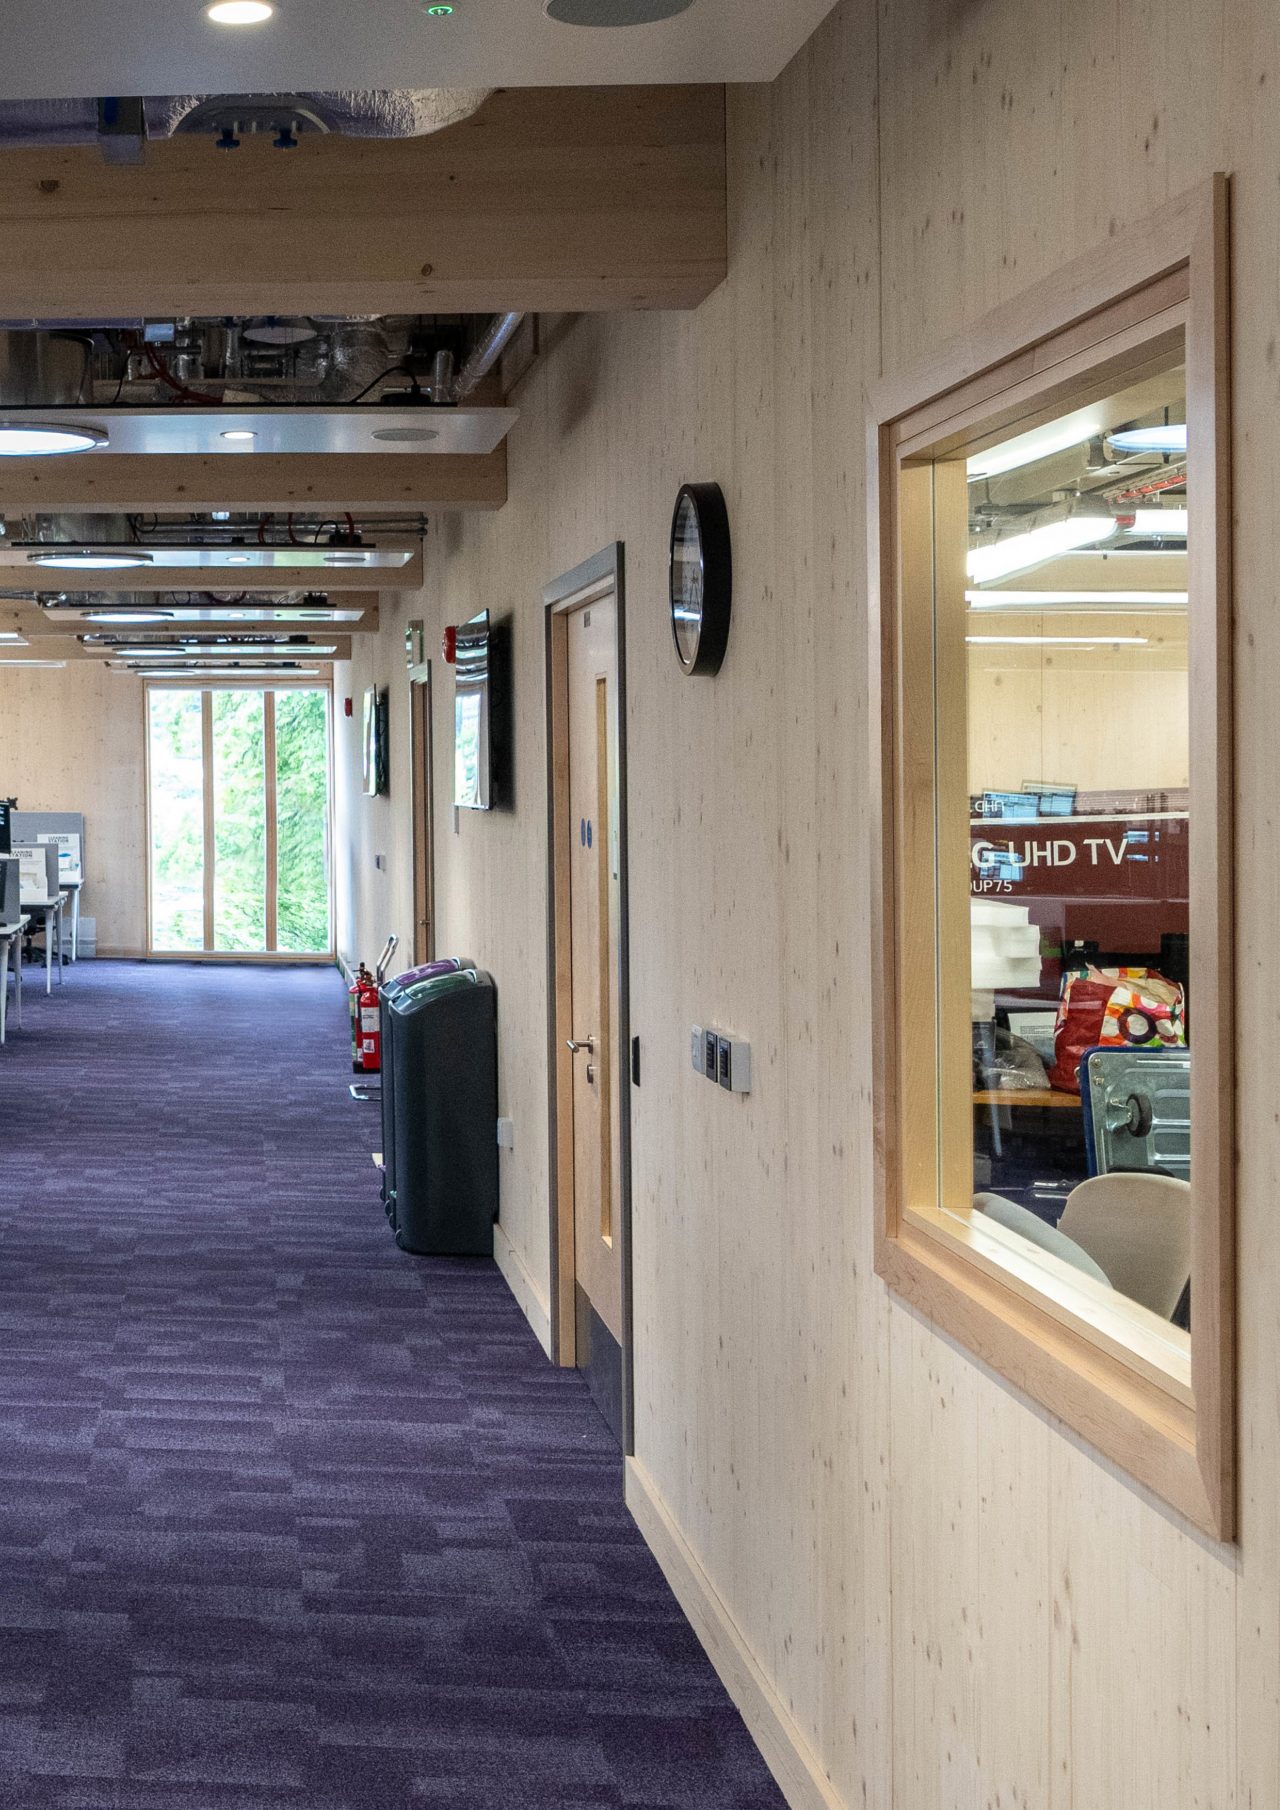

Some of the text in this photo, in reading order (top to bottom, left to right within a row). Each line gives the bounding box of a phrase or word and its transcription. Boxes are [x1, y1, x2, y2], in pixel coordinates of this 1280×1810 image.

[970, 838, 1128, 868] G UHD TV
